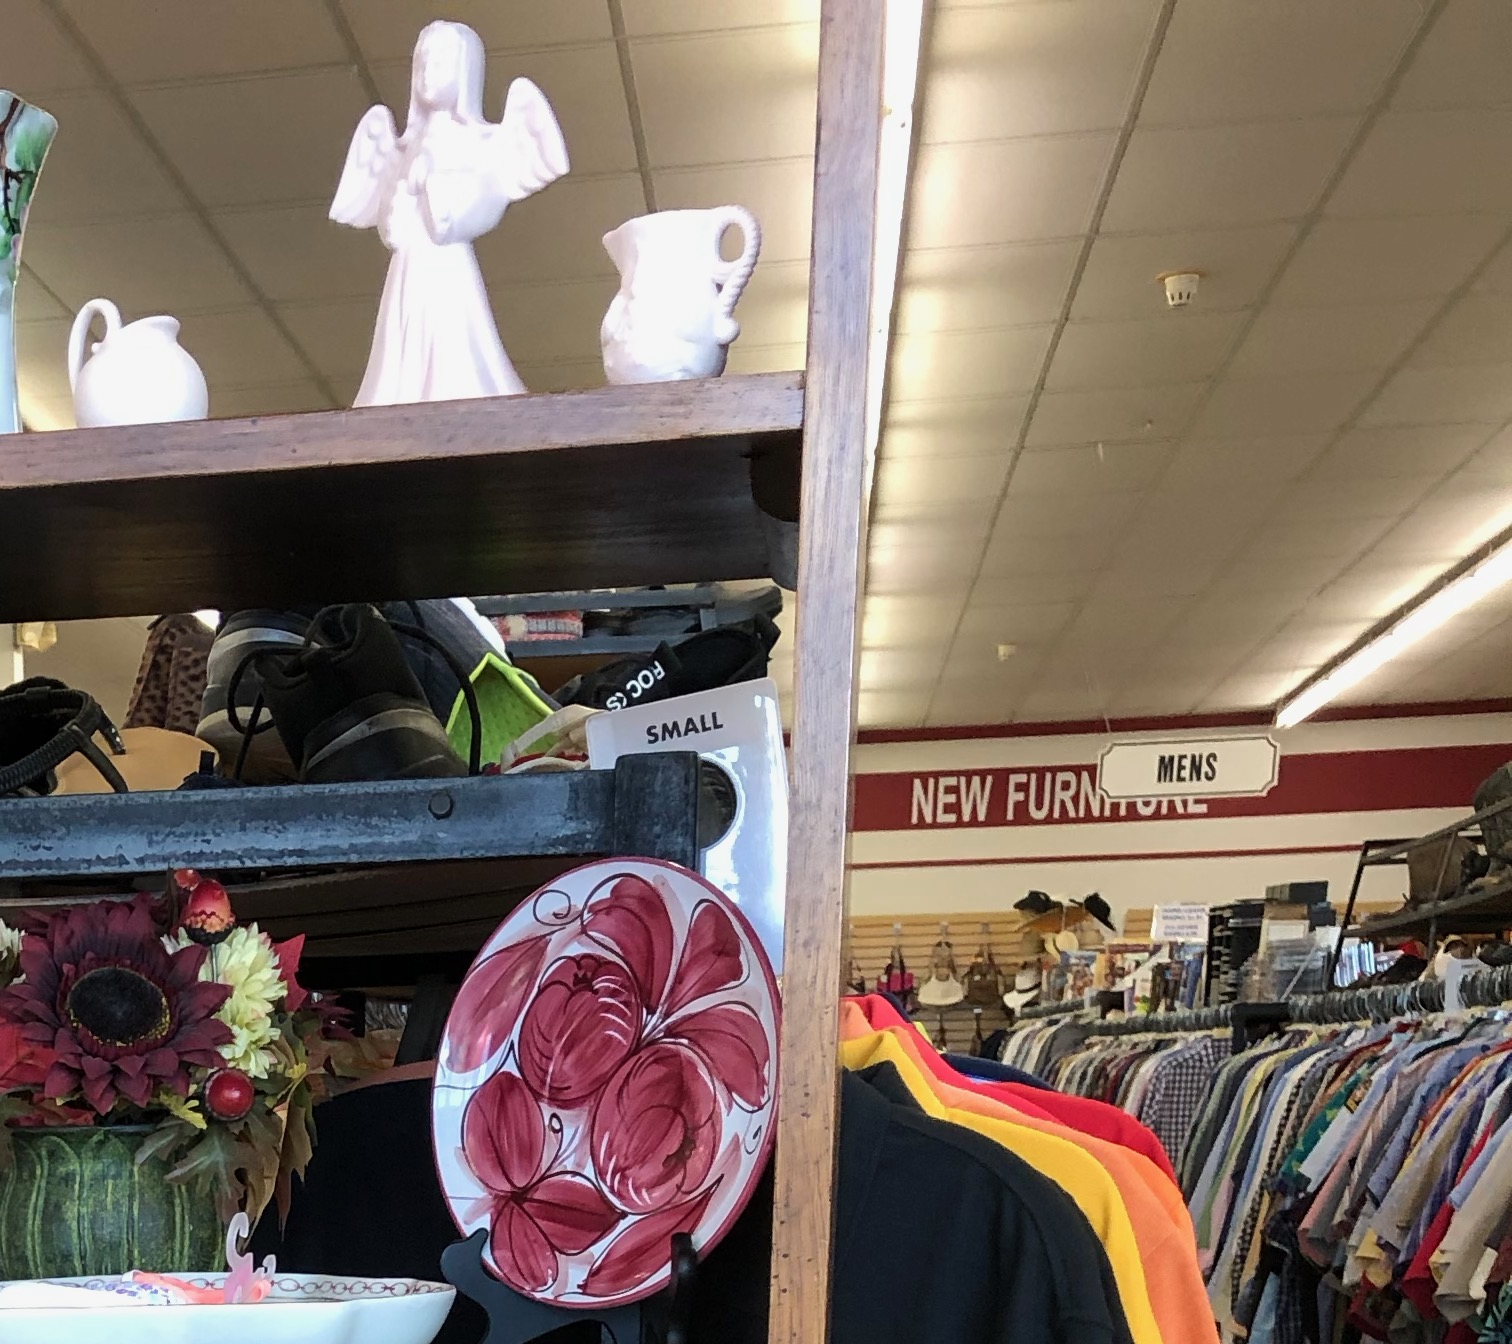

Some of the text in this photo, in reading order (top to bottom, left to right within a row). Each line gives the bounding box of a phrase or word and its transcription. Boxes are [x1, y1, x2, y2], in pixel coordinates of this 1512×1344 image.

[646, 711, 724, 745] SMALL
[1156, 752, 1218, 784] MENS
[911, 775, 993, 824] NEW
